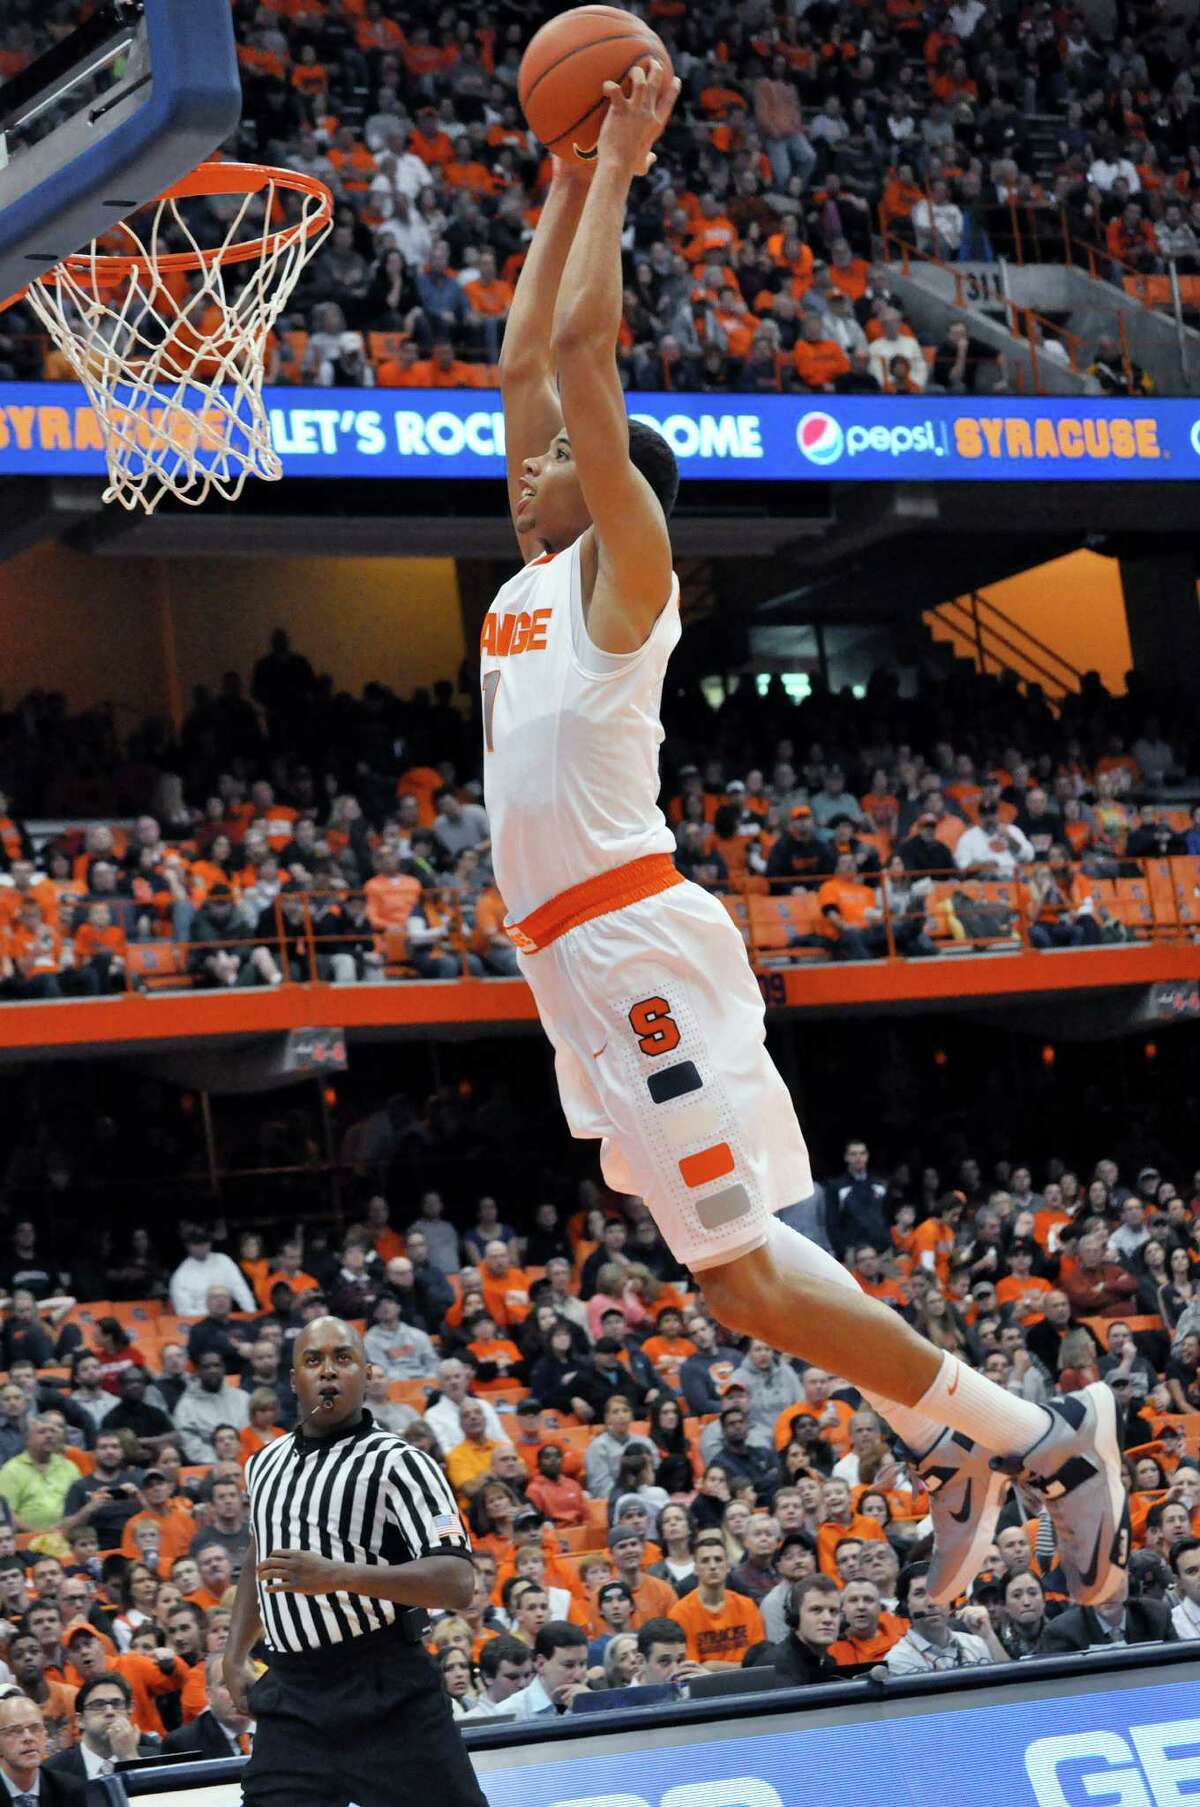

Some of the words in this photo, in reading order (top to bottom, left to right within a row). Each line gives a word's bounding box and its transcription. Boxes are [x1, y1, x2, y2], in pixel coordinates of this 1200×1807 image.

[966, 271, 1003, 303] 311
[269, 408, 387, 455] LET'S
[628, 413, 764, 458] OME
[954, 416, 1161, 459] SYRACUSE
[628, 996, 681, 1057] S
